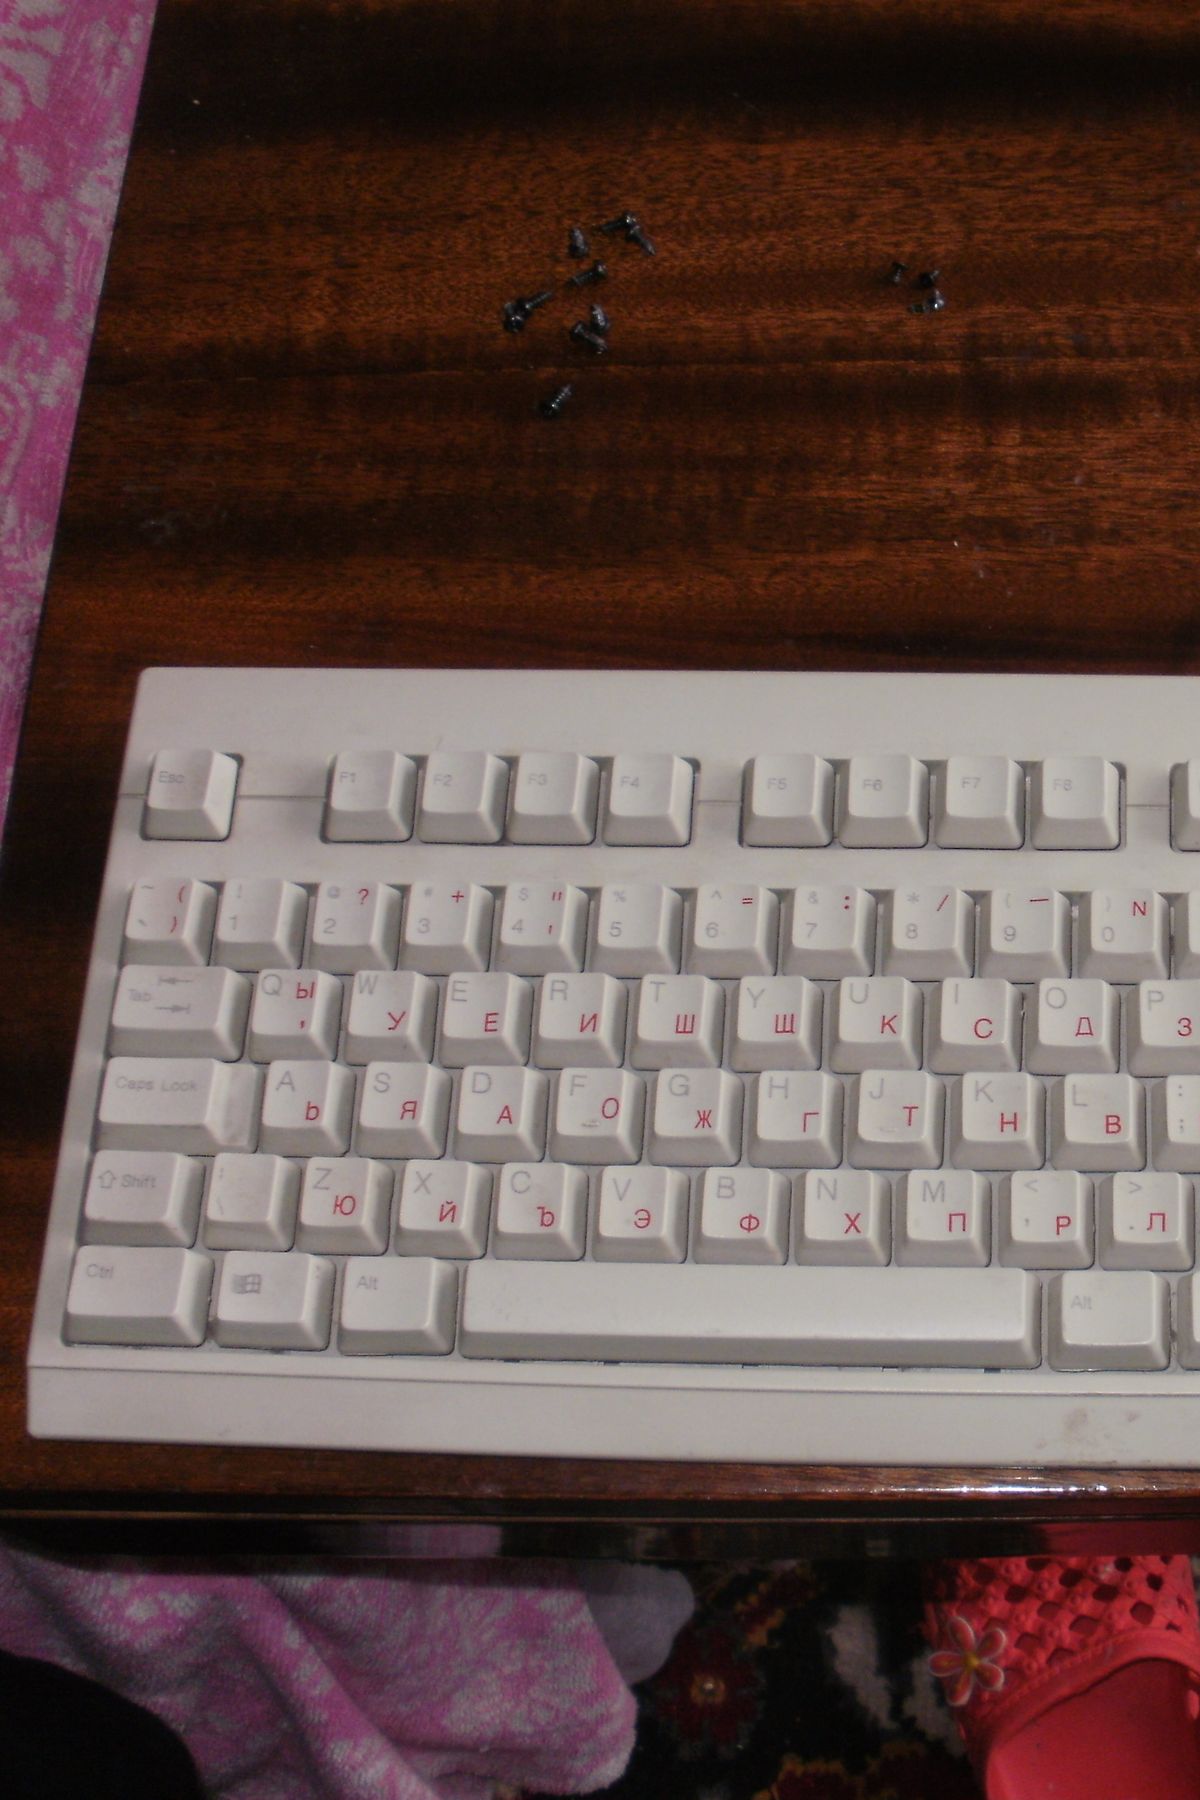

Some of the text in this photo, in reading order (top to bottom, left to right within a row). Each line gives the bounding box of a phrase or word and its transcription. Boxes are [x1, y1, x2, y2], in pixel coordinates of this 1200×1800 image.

[340, 771, 356, 783] F1
[434, 774, 453, 787] F2
[527, 773, 548, 786] F3
[621, 776, 640, 788] F4
[767, 777, 787, 790] F5
[863, 779, 883, 791] F6
[961, 777, 981, 788] F7
[323, 918, 337, 934] 2
[417, 917, 431, 934] 3
[511, 919, 523, 933] 4
[609, 921, 622, 937] 5
[705, 922, 719, 938] 6
[806, 922, 818, 938] 7
[905, 923, 918, 939] 8
[1003, 925, 1017, 942] 9
[262, 974, 283, 996] Q
[359, 975, 378, 995] W
[451, 981, 468, 1003] E
[550, 980, 568, 1001] R
[650, 981, 667, 1003] T
[849, 984, 869, 1005] U
[747, 987, 765, 1008] Y
[1148, 990, 1165, 1011] P
[115, 1076, 197, 1092] Caps Lock
[275, 1071, 296, 1092] A
[373, 1072, 391, 1094] S
[471, 1072, 493, 1094] D
[569, 1075, 587, 1096] F
[668, 1074, 690, 1097] G
[768, 1077, 789, 1099] H
[869, 1078, 885, 1100] J
[975, 1081, 994, 1103] K
[1072, 1084, 1088, 1107] L
[121, 1174, 156, 1189] Shift
[312, 1167, 333, 1191] Z
[716, 1176, 736, 1199] B
[817, 1178, 837, 1201] N
[922, 1180, 945, 1203] M
[86, 1263, 114, 1279] Ctrl
[357, 1275, 378, 1290] Alt
[1071, 1295, 1092, 1310] Alt
